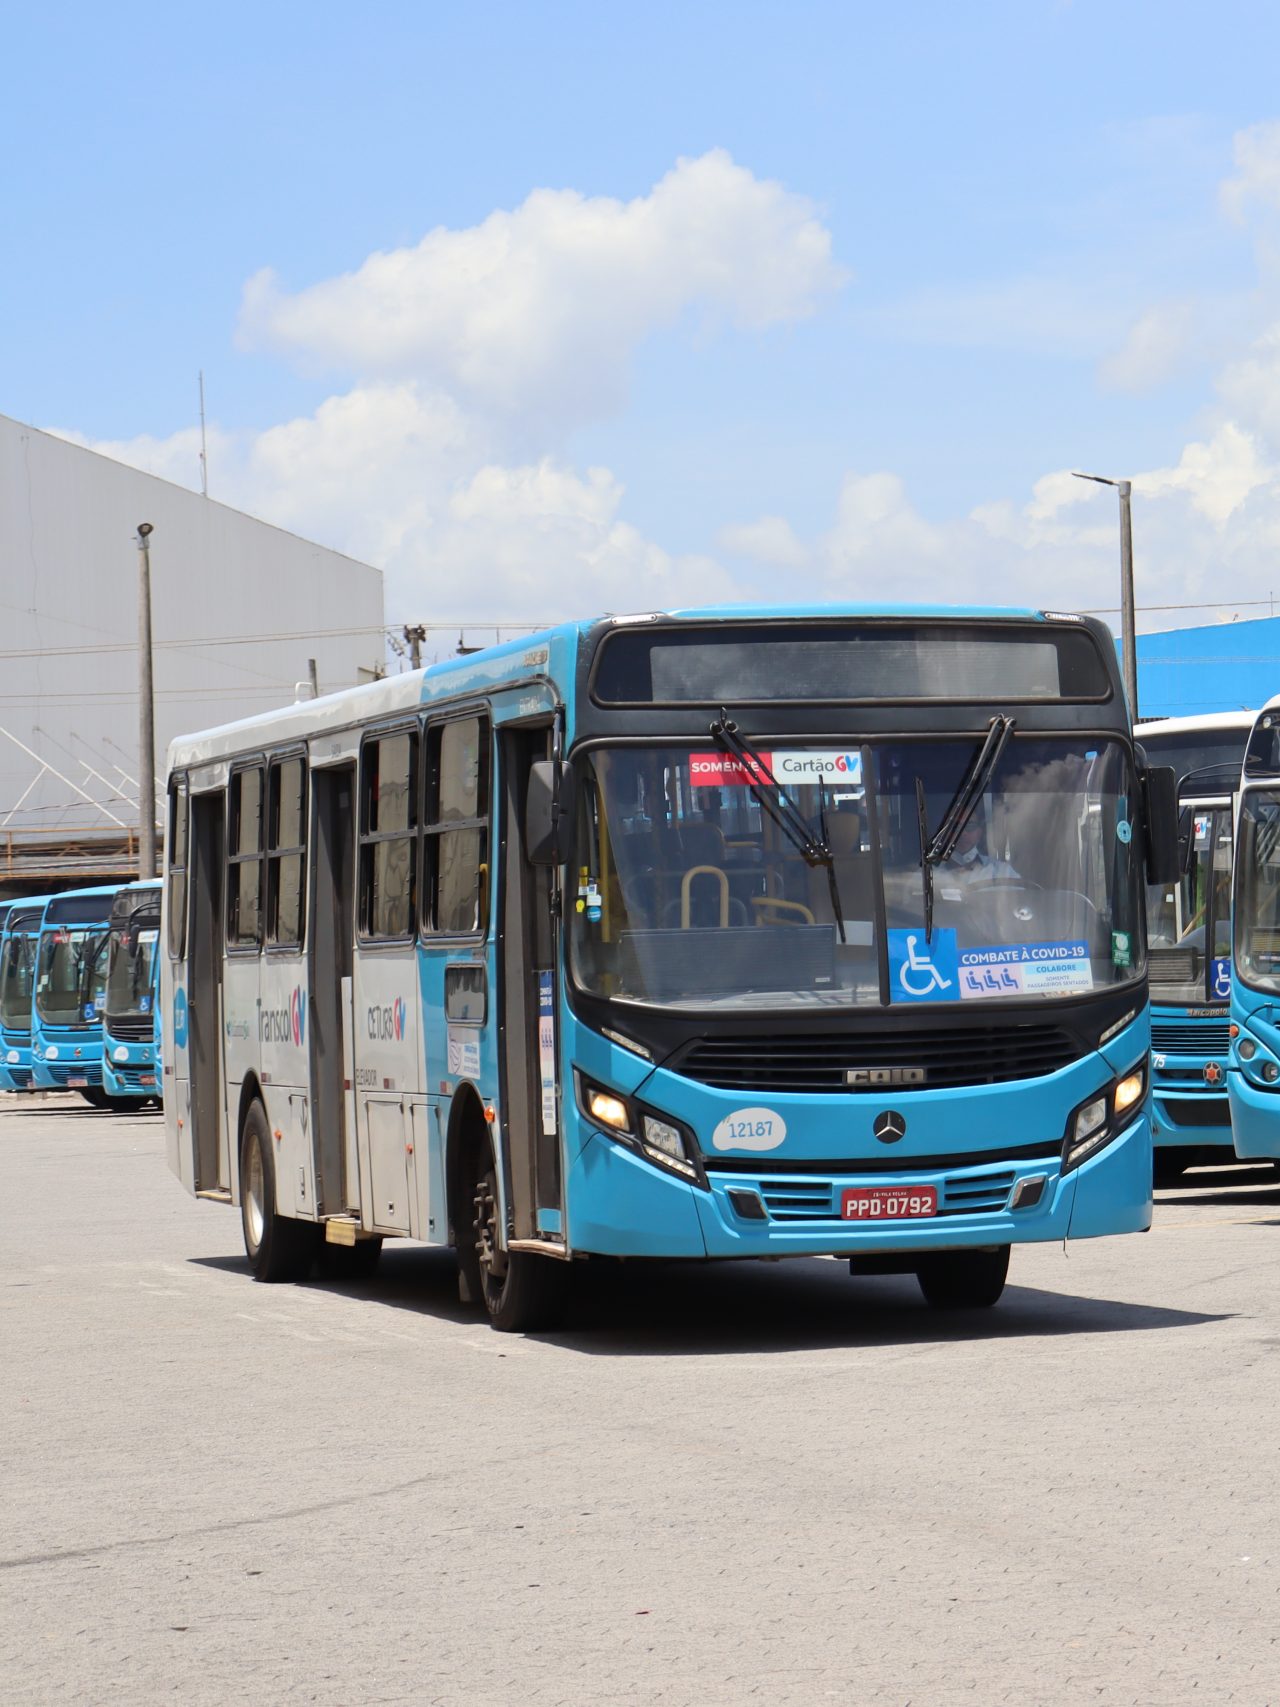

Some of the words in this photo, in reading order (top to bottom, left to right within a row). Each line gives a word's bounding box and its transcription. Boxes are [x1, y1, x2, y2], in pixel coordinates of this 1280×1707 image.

[961, 952, 1019, 965] COMBATE
[1021, 948, 1031, 960] À
[1034, 946, 1085, 960] COVID-19
[1036, 964, 1077, 973] COLABORE
[1027, 981, 1063, 989] PASSAGEIROS
[1152, 1053, 1167, 1068] 75
[729, 1120, 773, 1138] 12187
